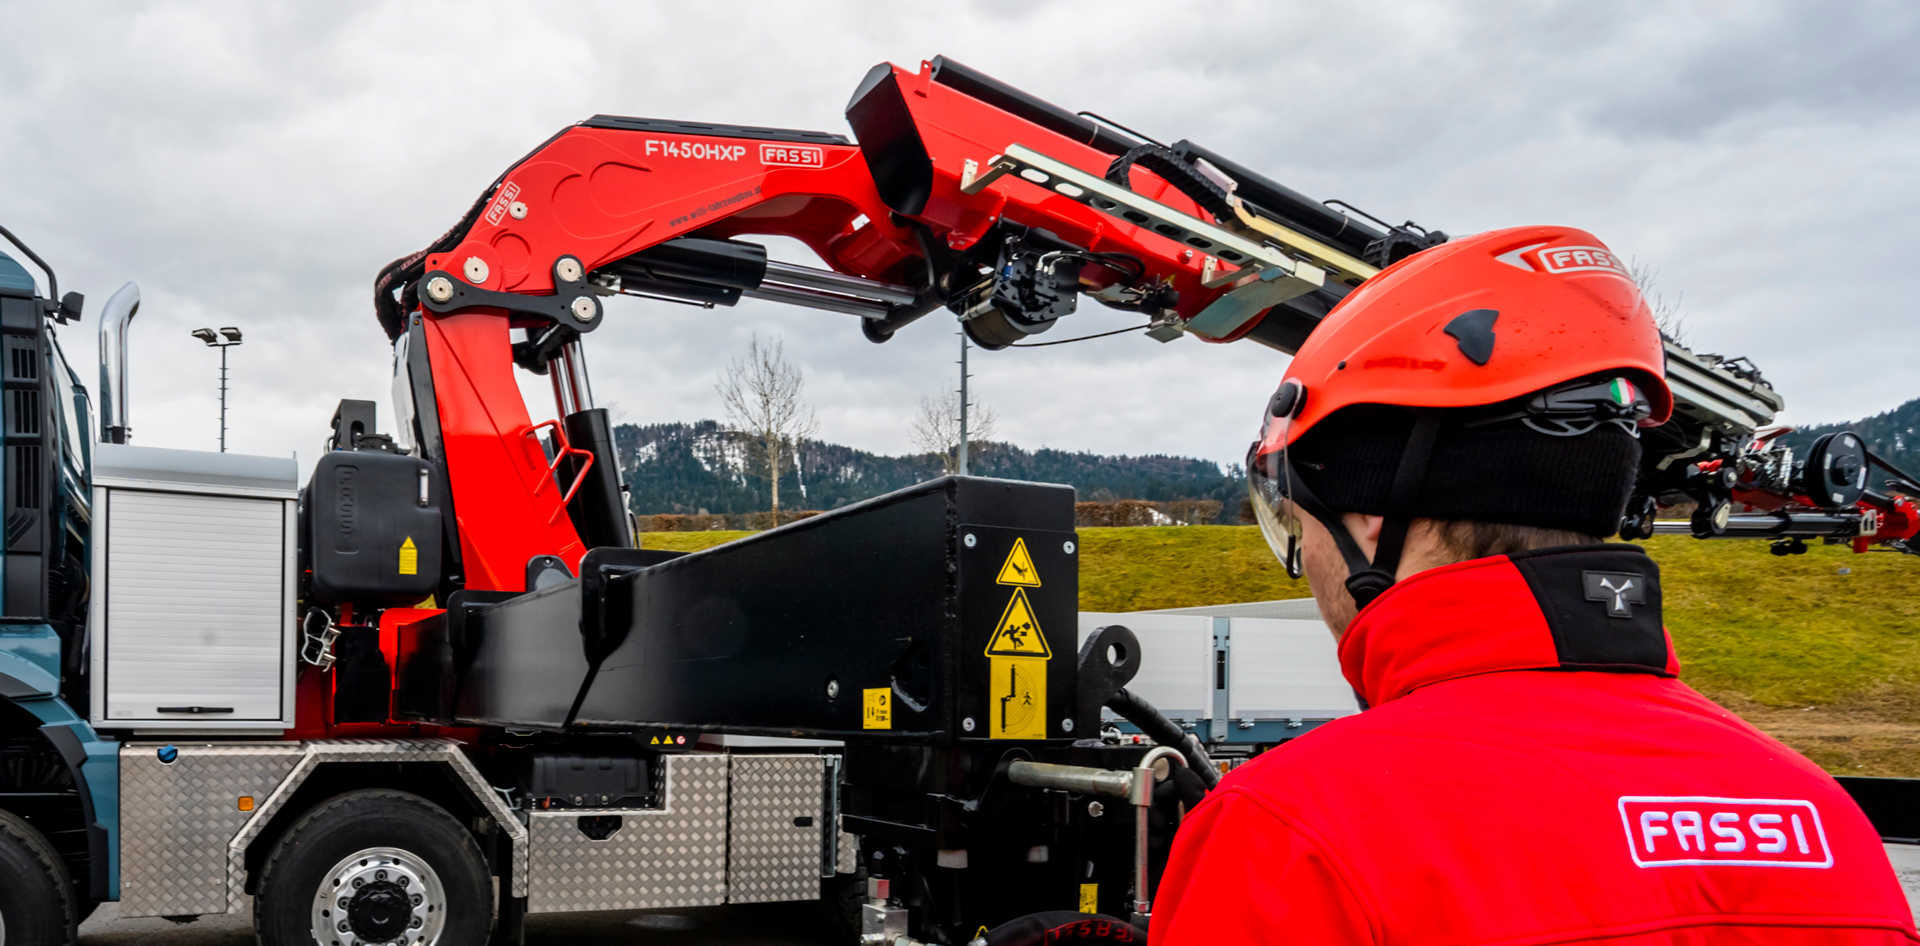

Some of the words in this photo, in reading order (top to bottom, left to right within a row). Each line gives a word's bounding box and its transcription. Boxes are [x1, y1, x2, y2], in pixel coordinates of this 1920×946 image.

[645, 139, 747, 162] F1450HXP
[765, 148, 818, 164] FASSI
[490, 185, 517, 222] FASSI
[1552, 250, 1625, 271] FASS
[1640, 810, 1811, 855] FASSI
